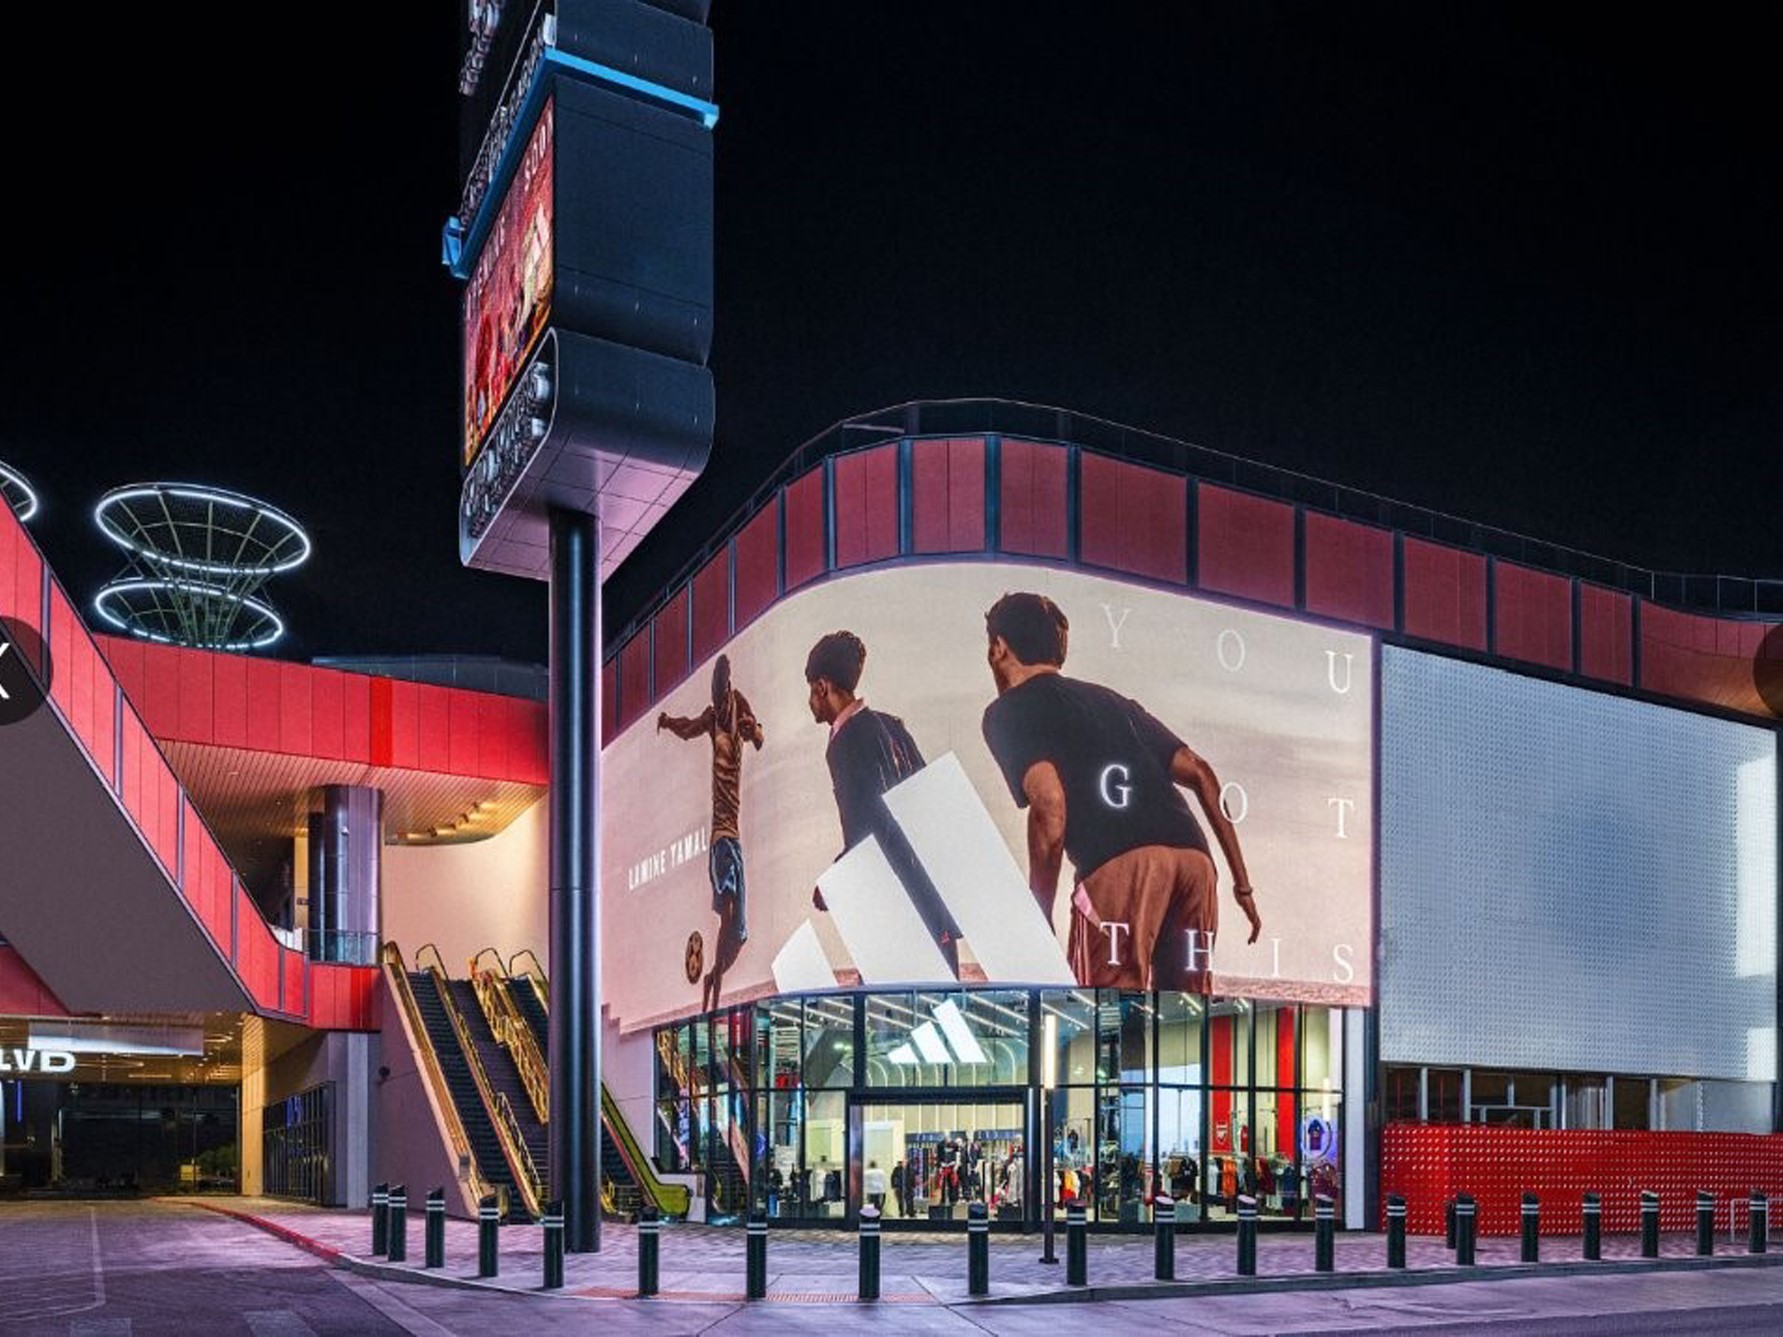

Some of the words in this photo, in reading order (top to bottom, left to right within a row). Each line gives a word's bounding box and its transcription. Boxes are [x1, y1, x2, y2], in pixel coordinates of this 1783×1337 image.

[1099, 603, 1354, 694] YOU
[1099, 763, 1355, 839] GOT
[628, 849, 666, 891] LAMINE
[670, 826, 707, 868] YAMAL
[1099, 921, 1354, 983] THIS
